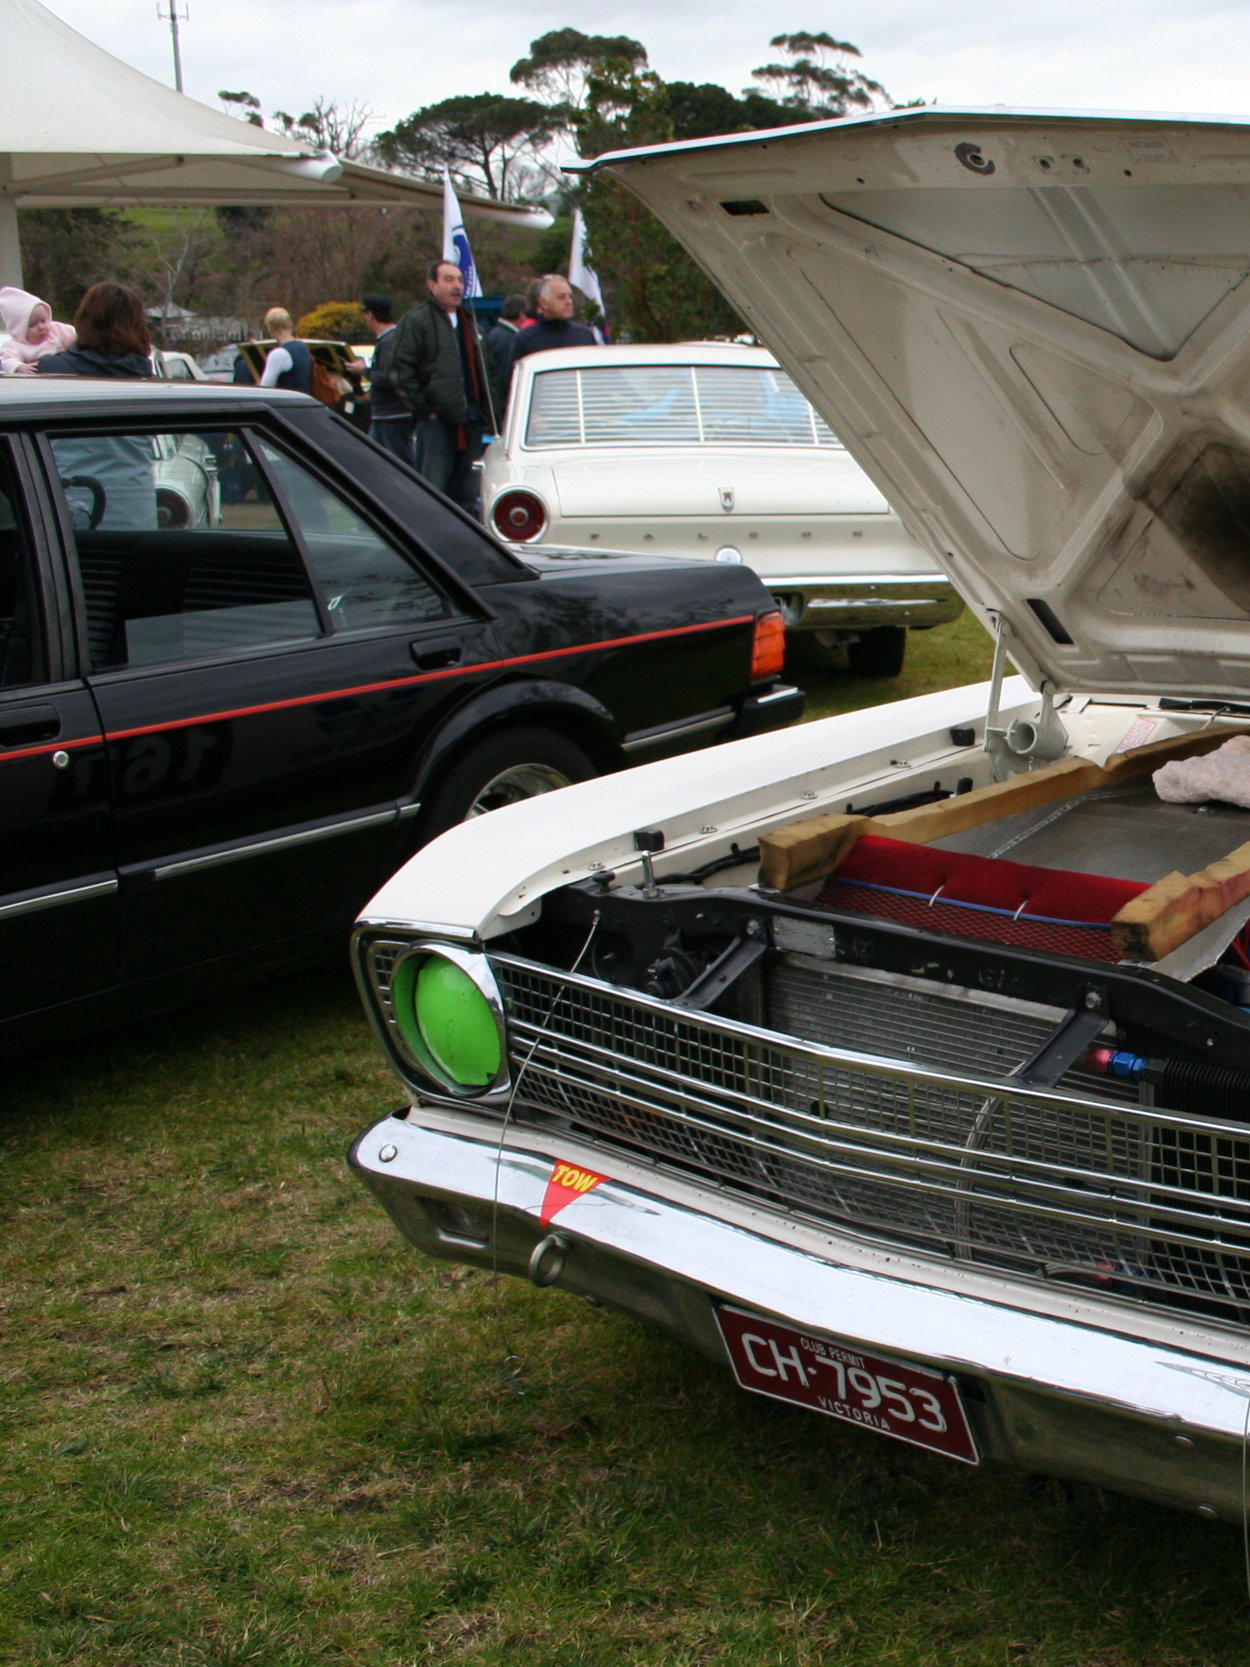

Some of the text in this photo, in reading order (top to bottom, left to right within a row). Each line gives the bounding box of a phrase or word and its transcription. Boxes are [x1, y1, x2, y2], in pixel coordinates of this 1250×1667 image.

[552, 1164, 599, 1192] TOW
[800, 1336, 865, 1369] CLUB PERMIT
[817, 1396, 891, 1431] VICTORIA
